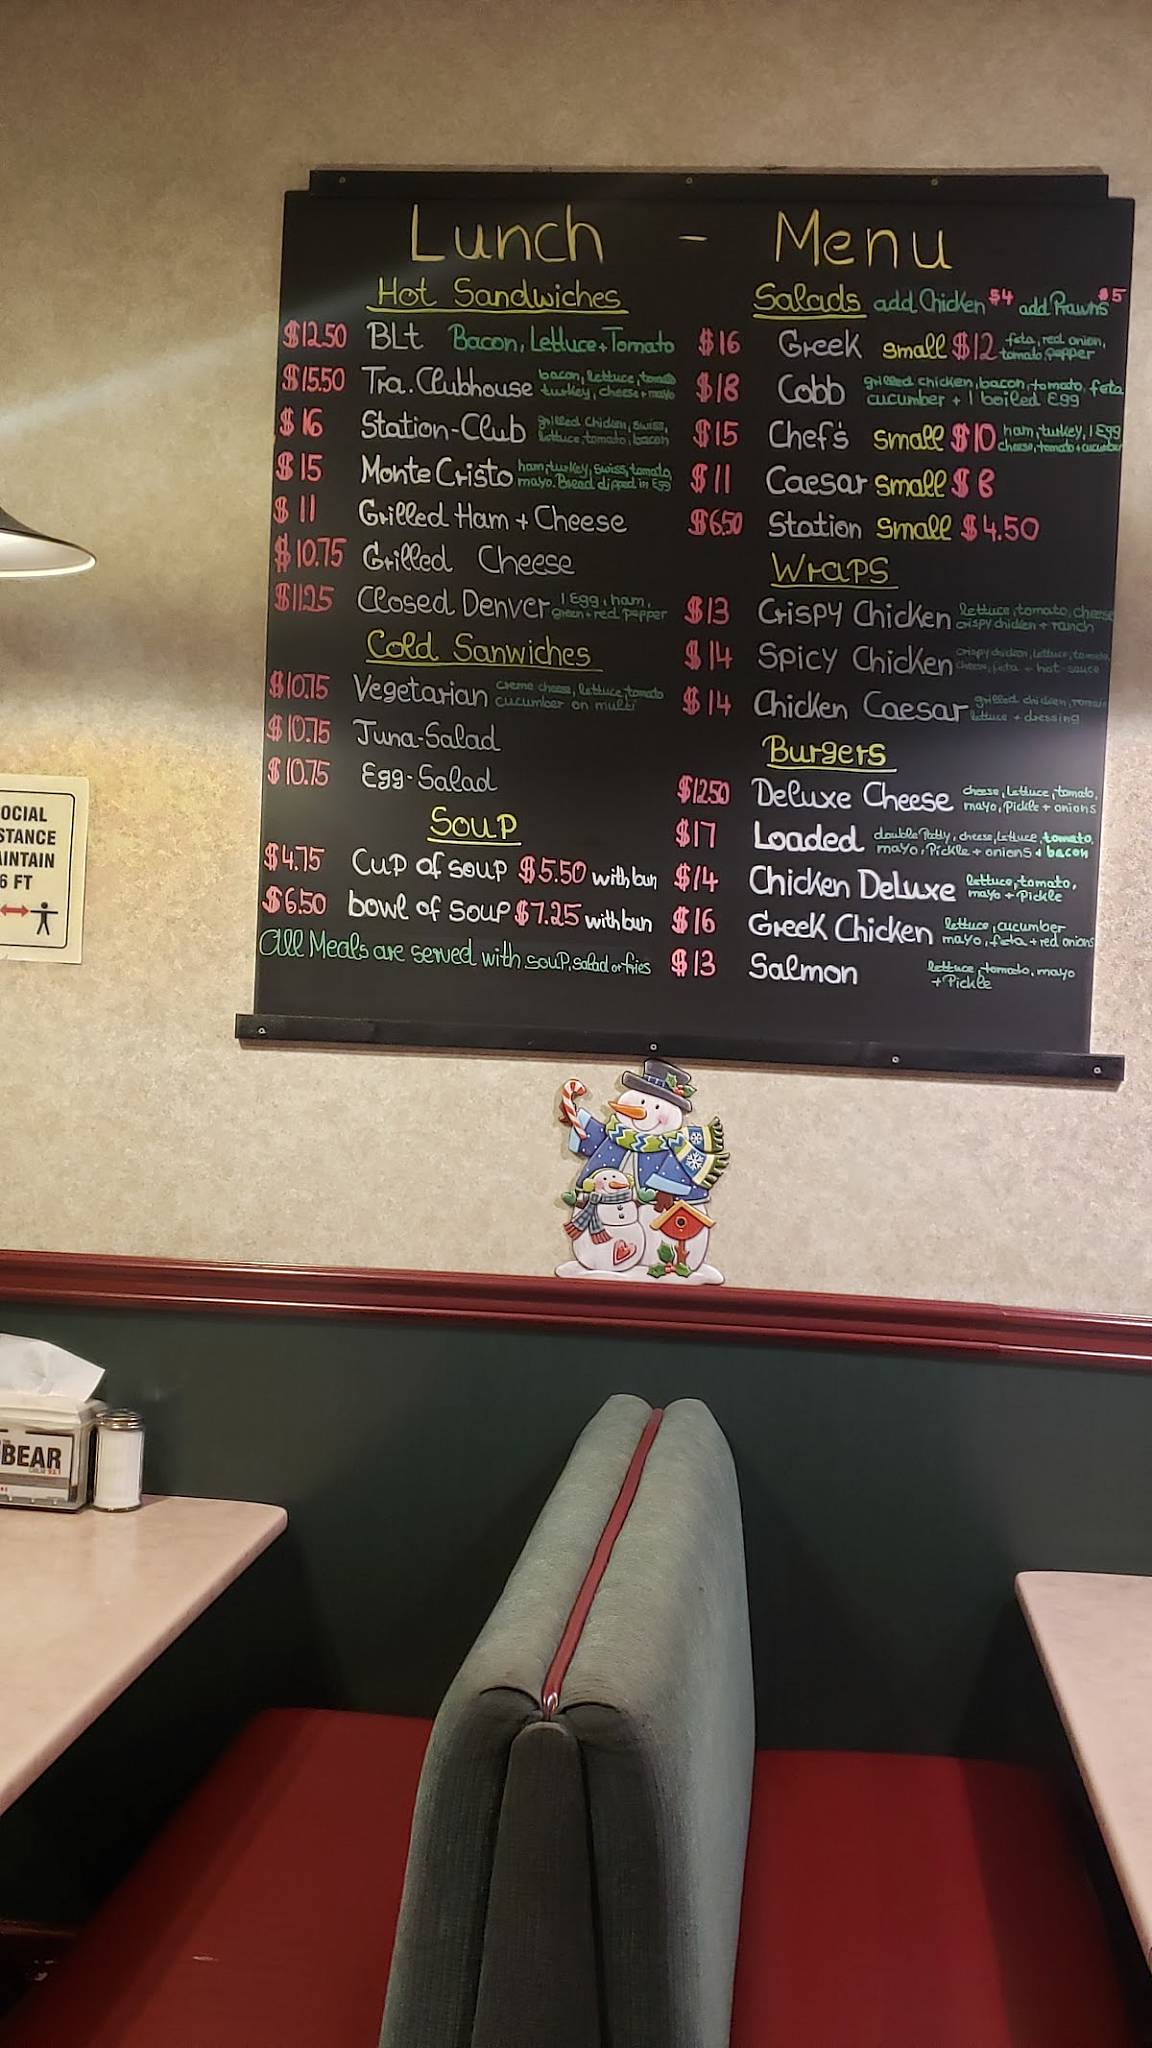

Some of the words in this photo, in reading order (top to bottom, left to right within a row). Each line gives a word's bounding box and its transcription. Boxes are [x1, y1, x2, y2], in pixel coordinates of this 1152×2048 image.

[410, 204, 603, 262] Lunch
[775, 209, 952, 269] Menu
[377, 276, 437, 307] Hot
[454, 277, 621, 309] Sandwiches
[753, 282, 861, 315] Salads
[873, 289, 917, 313] add
[919, 289, 986, 315] Chicken
[989, 288, 1014, 306] $4
[1019, 296, 1051, 316] add
[1049, 290, 1110, 316] Prawns
[698, 329, 741, 356] $16
[778, 329, 863, 359] Greek
[882, 332, 948, 360] small
[951, 331, 999, 360] $12
[1042, 332, 1065, 345] red
[361, 367, 413, 395] Tra.
[416, 367, 533, 398] Clubhouse
[696, 373, 739, 403] $18
[777, 373, 847, 406] Cobb
[864, 376, 913, 391] grilled
[1089, 379, 1124, 397] feta
[866, 390, 946, 407] cucumber
[980, 391, 1041, 407] boiled
[1047, 393, 1080, 407] Egg
[693, 419, 739, 448] $15
[768, 420, 849, 450] Chef's
[873, 425, 945, 452] small
[950, 422, 996, 452] $10
[1096, 424, 1121, 440] Egg
[275, 451, 323, 483] $15
[361, 454, 431, 486] Monte
[435, 455, 514, 489] Cristo
[555, 473, 596, 490] Bread
[690, 464, 731, 494] $11
[766, 465, 868, 496] Caesar
[874, 469, 946, 498] small
[358, 499, 450, 528] Grilled
[453, 502, 510, 531] Ham
[515, 509, 529, 530] +
[534, 504, 627, 533] Cheese
[768, 511, 862, 539] Station
[876, 515, 952, 541] small
[960, 513, 1040, 542] $4.50
[273, 533, 348, 573] $10.75
[362, 541, 454, 573] Grilled
[478, 544, 575, 576] Cheese
[357, 583, 456, 617] Closed
[461, 588, 551, 621] Denver
[683, 595, 730, 626] $13
[758, 598, 842, 628] Crispy
[853, 599, 952, 630] Chicken
[1050, 620, 1094, 633] ranch
[367, 629, 439, 661] Cold
[453, 632, 591, 667] Sanwiches
[684, 639, 733, 671] $14
[757, 642, 838, 673] Spicy
[852, 644, 953, 676] Chicken
[269, 671, 331, 701] $10.75
[353, 674, 488, 707] Vegetarian
[495, 696, 564, 709] cucumber
[571, 700, 589, 711] on
[682, 686, 731, 717] $14
[753, 689, 848, 720] Chicken
[863, 690, 969, 723] Caesar
[266, 713, 331, 745] $10.75
[762, 734, 886, 767] Burgers
[267, 757, 331, 786] $10.75
[751, 777, 851, 809] Deluxe
[863, 781, 954, 812] Cheese
[1054, 803, 1096, 814] onions
[675, 818, 717, 848] $17
[752, 820, 865, 854] Loaded
[873, 827, 918, 841] double
[0, 851, 55, 868] INTAIN
[263, 842, 325, 872] $4.75
[415, 852, 446, 880] of
[518, 855, 588, 885] $5.50
[591, 864, 630, 888] with
[631, 865, 657, 890] bun
[985, 846, 1032, 858] onions
[1046, 846, 1089, 859] bacon
[13, 874, 33, 890] FT
[673, 862, 719, 892] $14
[748, 864, 851, 899] Chicken
[262, 886, 327, 916] $6.50
[348, 889, 409, 921] bowl
[415, 895, 441, 922] of
[514, 900, 583, 927] $7.25
[584, 908, 620, 931] with
[621, 907, 653, 932] bun
[671, 906, 716, 934] $16
[748, 909, 828, 942] Greek
[834, 913, 934, 946] Chicken
[989, 935, 1028, 948] feta
[1039, 932, 1059, 948] red
[1062, 935, 1095, 948] onions
[997, 919, 1067, 934] cucumber
[258, 928, 305, 957] All
[310, 930, 369, 960] Meals
[373, 943, 405, 963] are
[412, 939, 477, 966] served
[481, 942, 521, 970] with
[572, 952, 609, 973] salad
[621, 951, 652, 975] fries
[670, 949, 717, 977] $13
[748, 951, 858, 985] Salmon
[1036, 968, 1076, 981] mayo
[2, 1444, 61, 1469] BEAR
